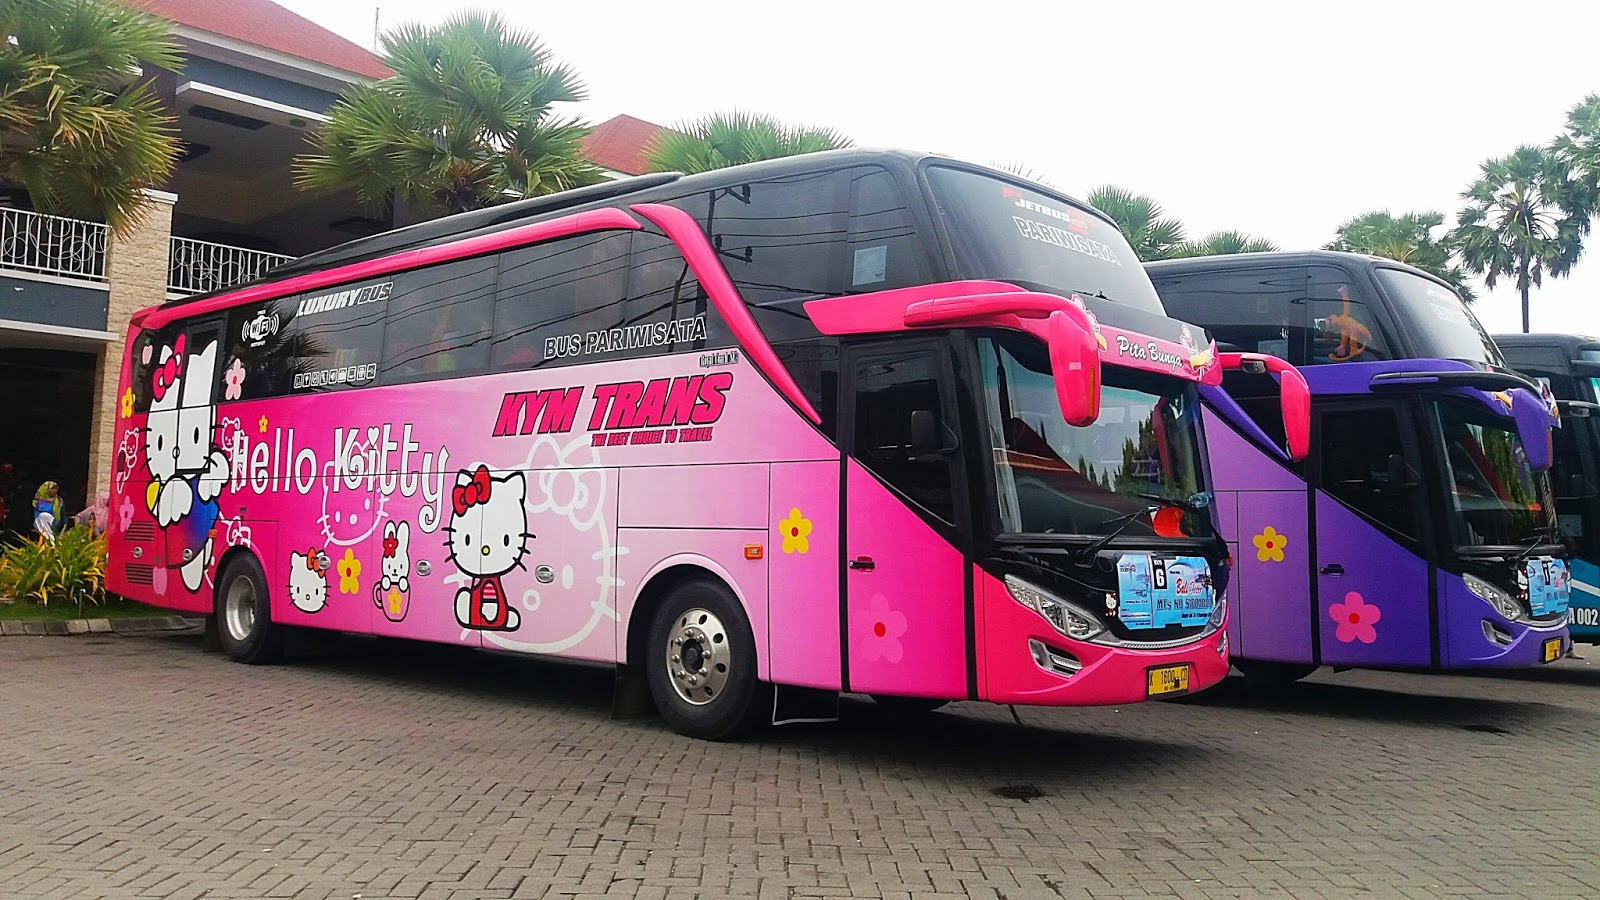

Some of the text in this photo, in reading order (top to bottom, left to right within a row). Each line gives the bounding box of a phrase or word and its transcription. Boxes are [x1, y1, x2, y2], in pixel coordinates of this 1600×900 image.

[1014, 198, 1071, 223] JETBUS
[1012, 215, 1123, 266] PARIWISATA
[543, 316, 707, 359] BUS PARIWISATA
[1116, 335, 1183, 371] Pita Bunga
[491, 371, 734, 437] KYM TRANS
[591, 427, 713, 447] THE BEST CHOICE TO TRAVEL
[230, 423, 451, 534] Hello Kitty
[1155, 568, 1165, 587] 6
